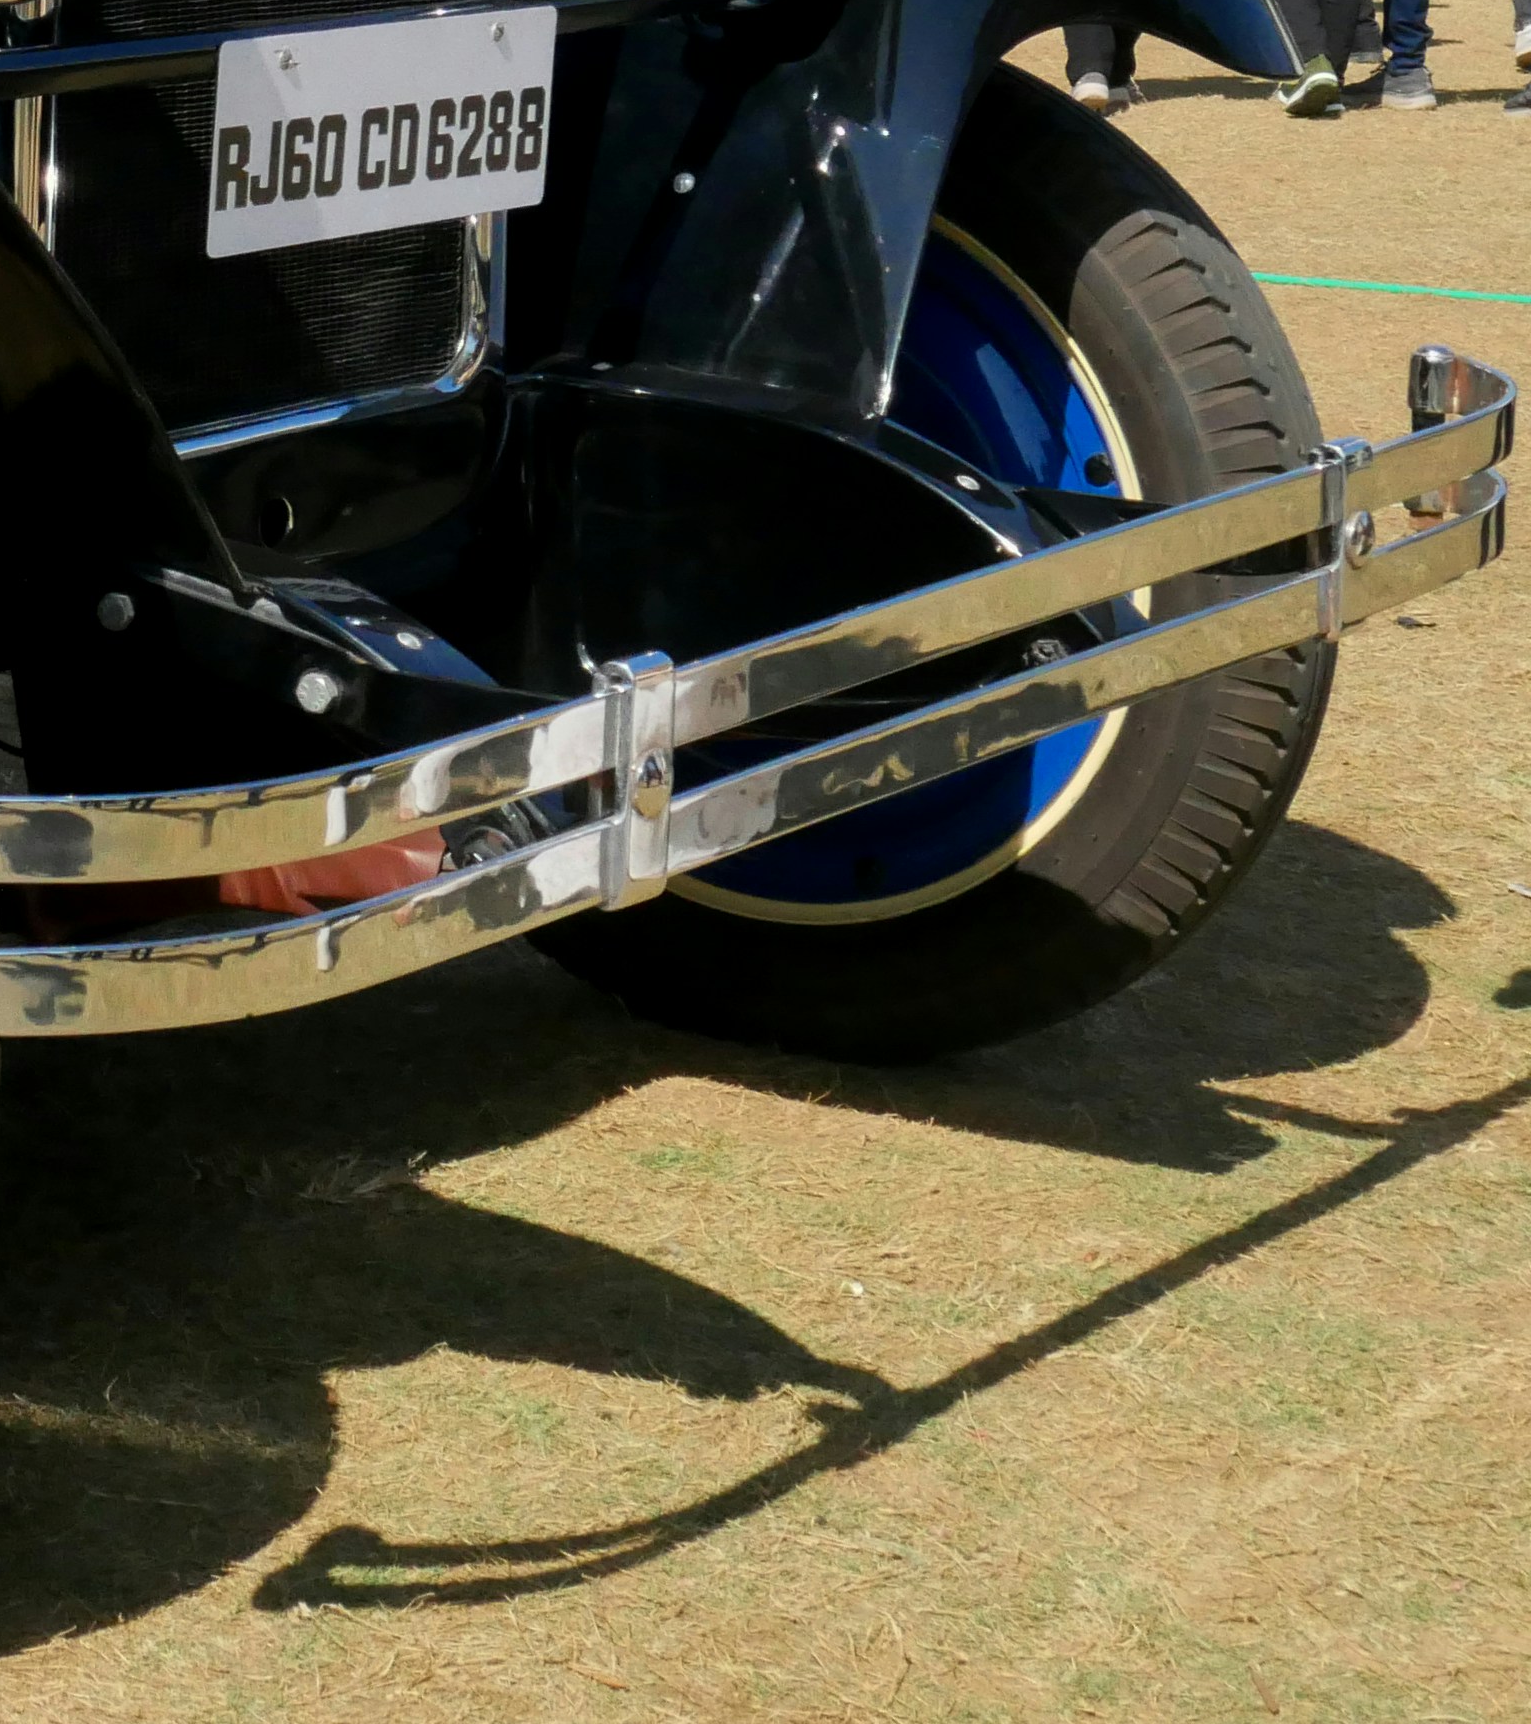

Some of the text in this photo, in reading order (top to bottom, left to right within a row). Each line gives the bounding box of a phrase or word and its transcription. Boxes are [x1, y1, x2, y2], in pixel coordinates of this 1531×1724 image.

[214, 86, 546, 212] RJ60 CD 6288
